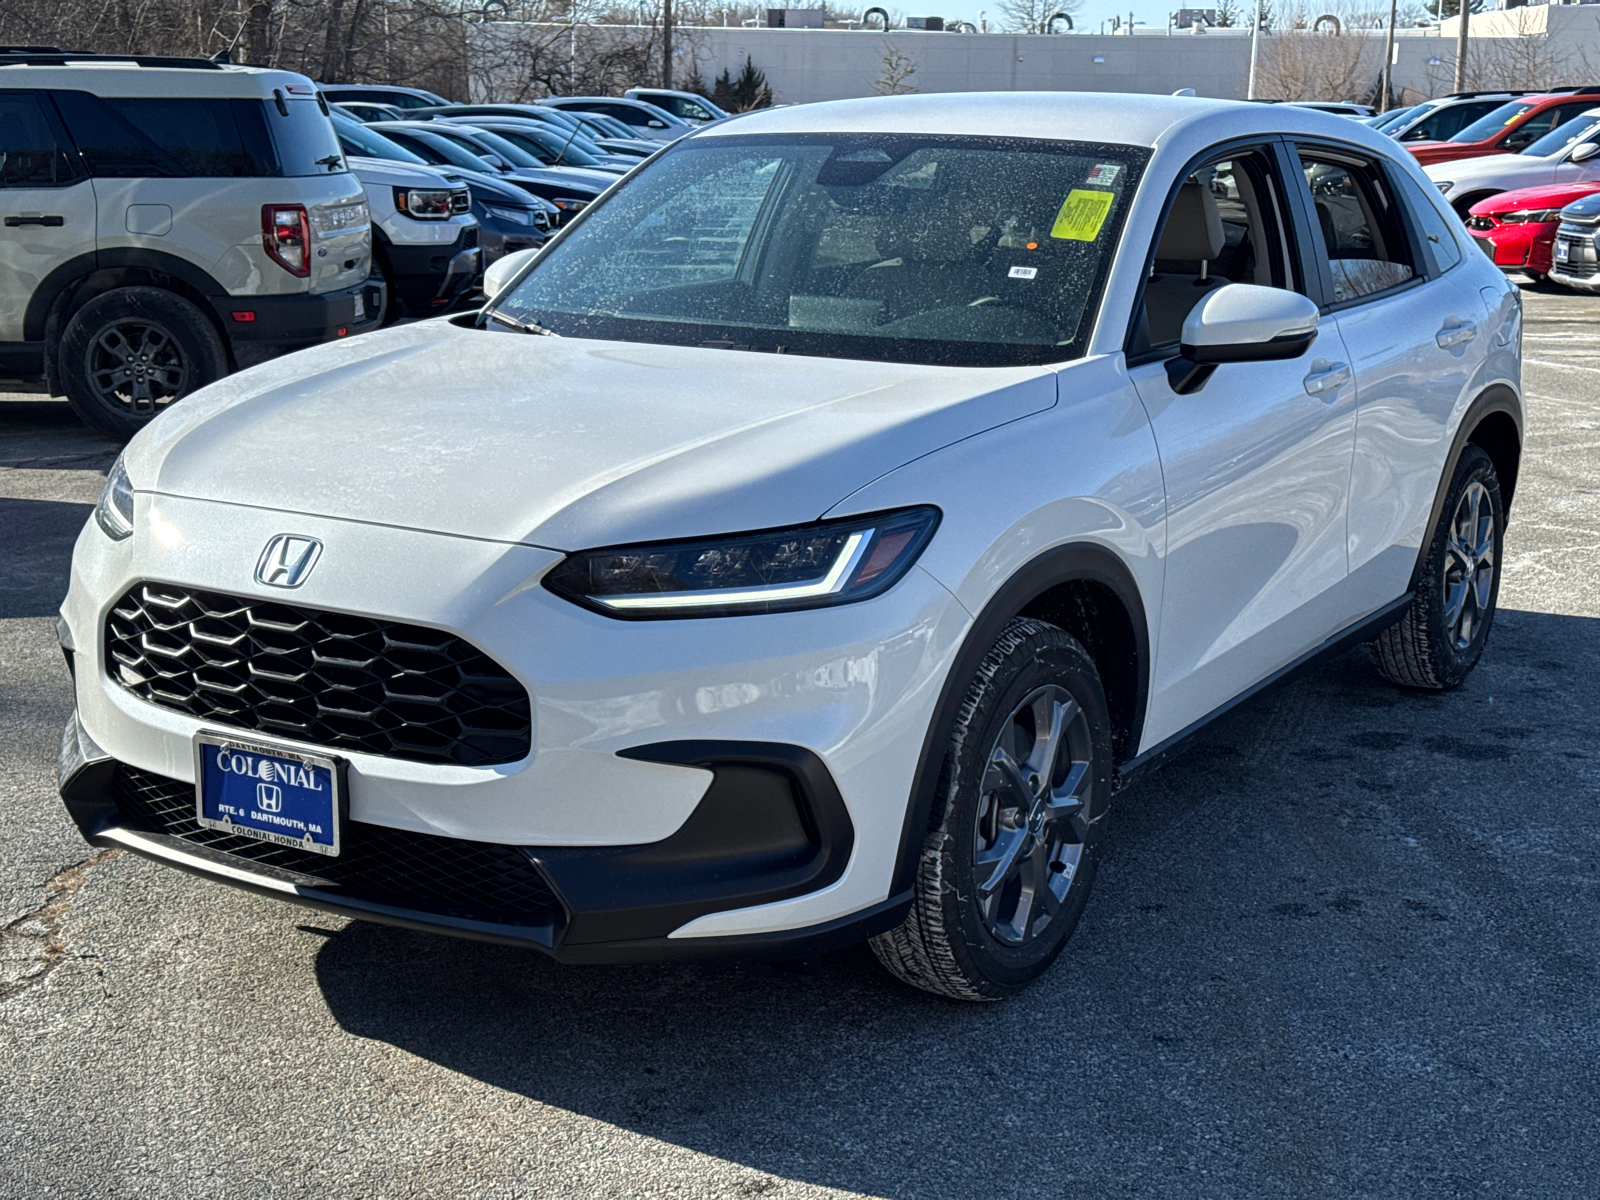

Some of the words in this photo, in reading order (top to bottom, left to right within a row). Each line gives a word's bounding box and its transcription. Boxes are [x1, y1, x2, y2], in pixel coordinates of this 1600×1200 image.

[216, 750, 322, 791] COLONIAL
[288, 753, 303, 761] MA
[218, 803, 238, 816] RTE.
[238, 808, 245, 817] 6
[250, 810, 307, 832] DARTMOUTH,
[308, 823, 322, 834] MA
[231, 825, 273, 841] COLONIAL
[273, 834, 304, 849] HONDA
